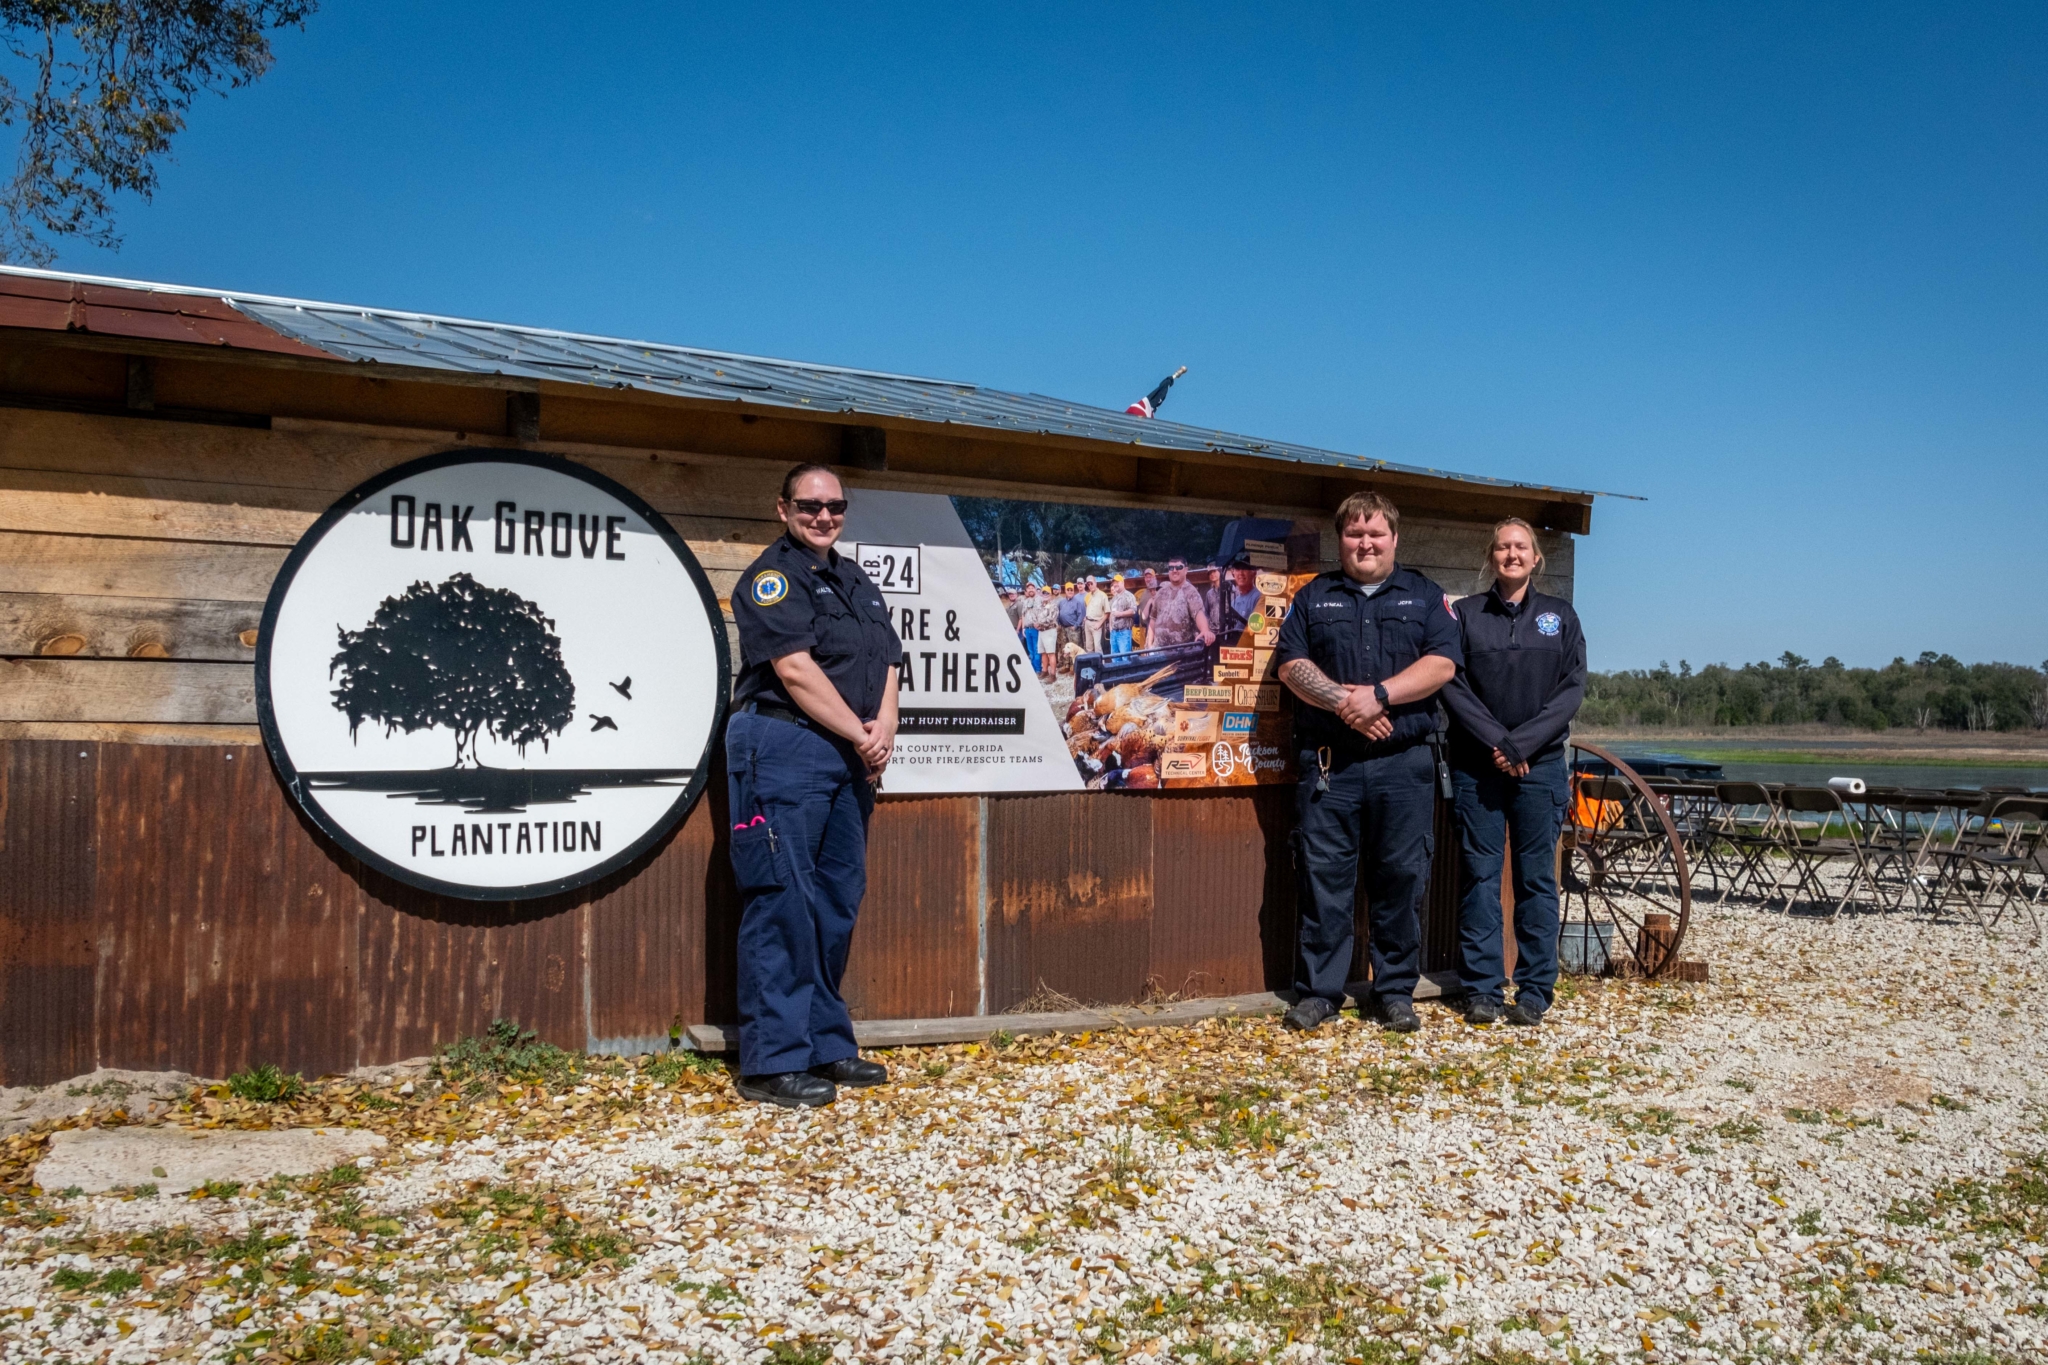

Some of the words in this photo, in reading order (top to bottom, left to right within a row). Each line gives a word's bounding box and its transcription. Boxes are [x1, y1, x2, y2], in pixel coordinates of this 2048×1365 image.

[391, 494, 475, 553] OAK
[495, 500, 627, 561] GROVE
[882, 554, 914, 588] 24
[945, 609, 960, 642] &
[1221, 649, 1253, 661] TIRES
[1218, 670, 1239, 678] Sunbelt
[918, 717, 949, 725] HUNT
[952, 717, 1017, 725] FUNDRAISER
[1225, 715, 1255, 729] DHM
[907, 745, 955, 753] COUNTY,
[959, 744, 1004, 752] FLORIDA
[1234, 743, 1279, 763] Jackson
[909, 756, 932, 764] OUR
[936, 756, 1006, 764] FIRE/RESCUE
[1010, 755, 1043, 763] TEAMS
[1166, 756, 1204, 770] REV
[1244, 755, 1286, 774] County
[411, 820, 602, 858] PLANTATION
